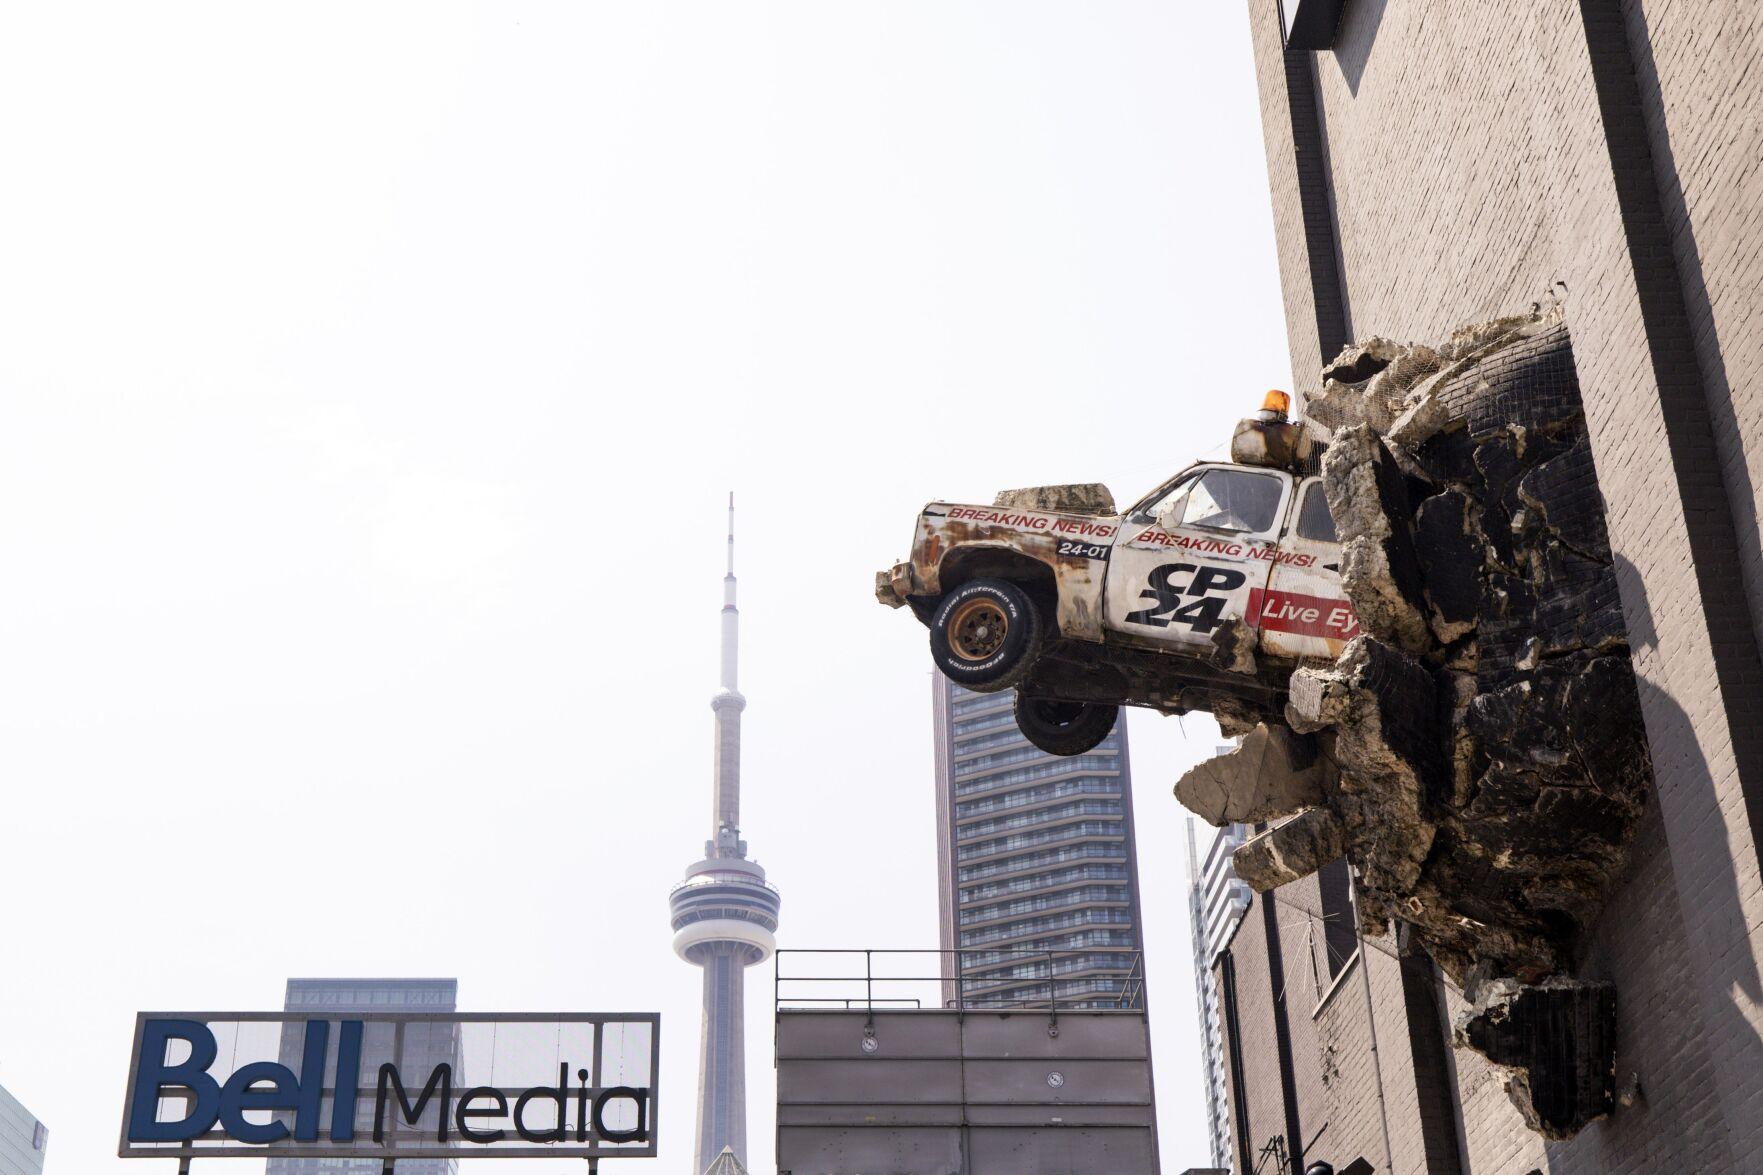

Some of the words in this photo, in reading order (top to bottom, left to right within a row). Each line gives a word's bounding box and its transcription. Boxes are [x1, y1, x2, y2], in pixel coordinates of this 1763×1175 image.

[947, 508, 1048, 529] BREAKING
[1052, 520, 1118, 537] NEWS!
[1059, 542, 1108, 558] 24-01
[1137, 531, 1242, 556] BREAKING
[1246, 547, 1317, 568] NEWS!
[1147, 562, 1247, 597] CP
[938, 597, 959, 627] Radial
[1124, 589, 1229, 634] 24
[1262, 598, 1320, 623] Live
[948, 652, 1005, 671] BFGoodrich
[128, 1019, 364, 1144] Bell
[372, 1062, 649, 1143] Media
